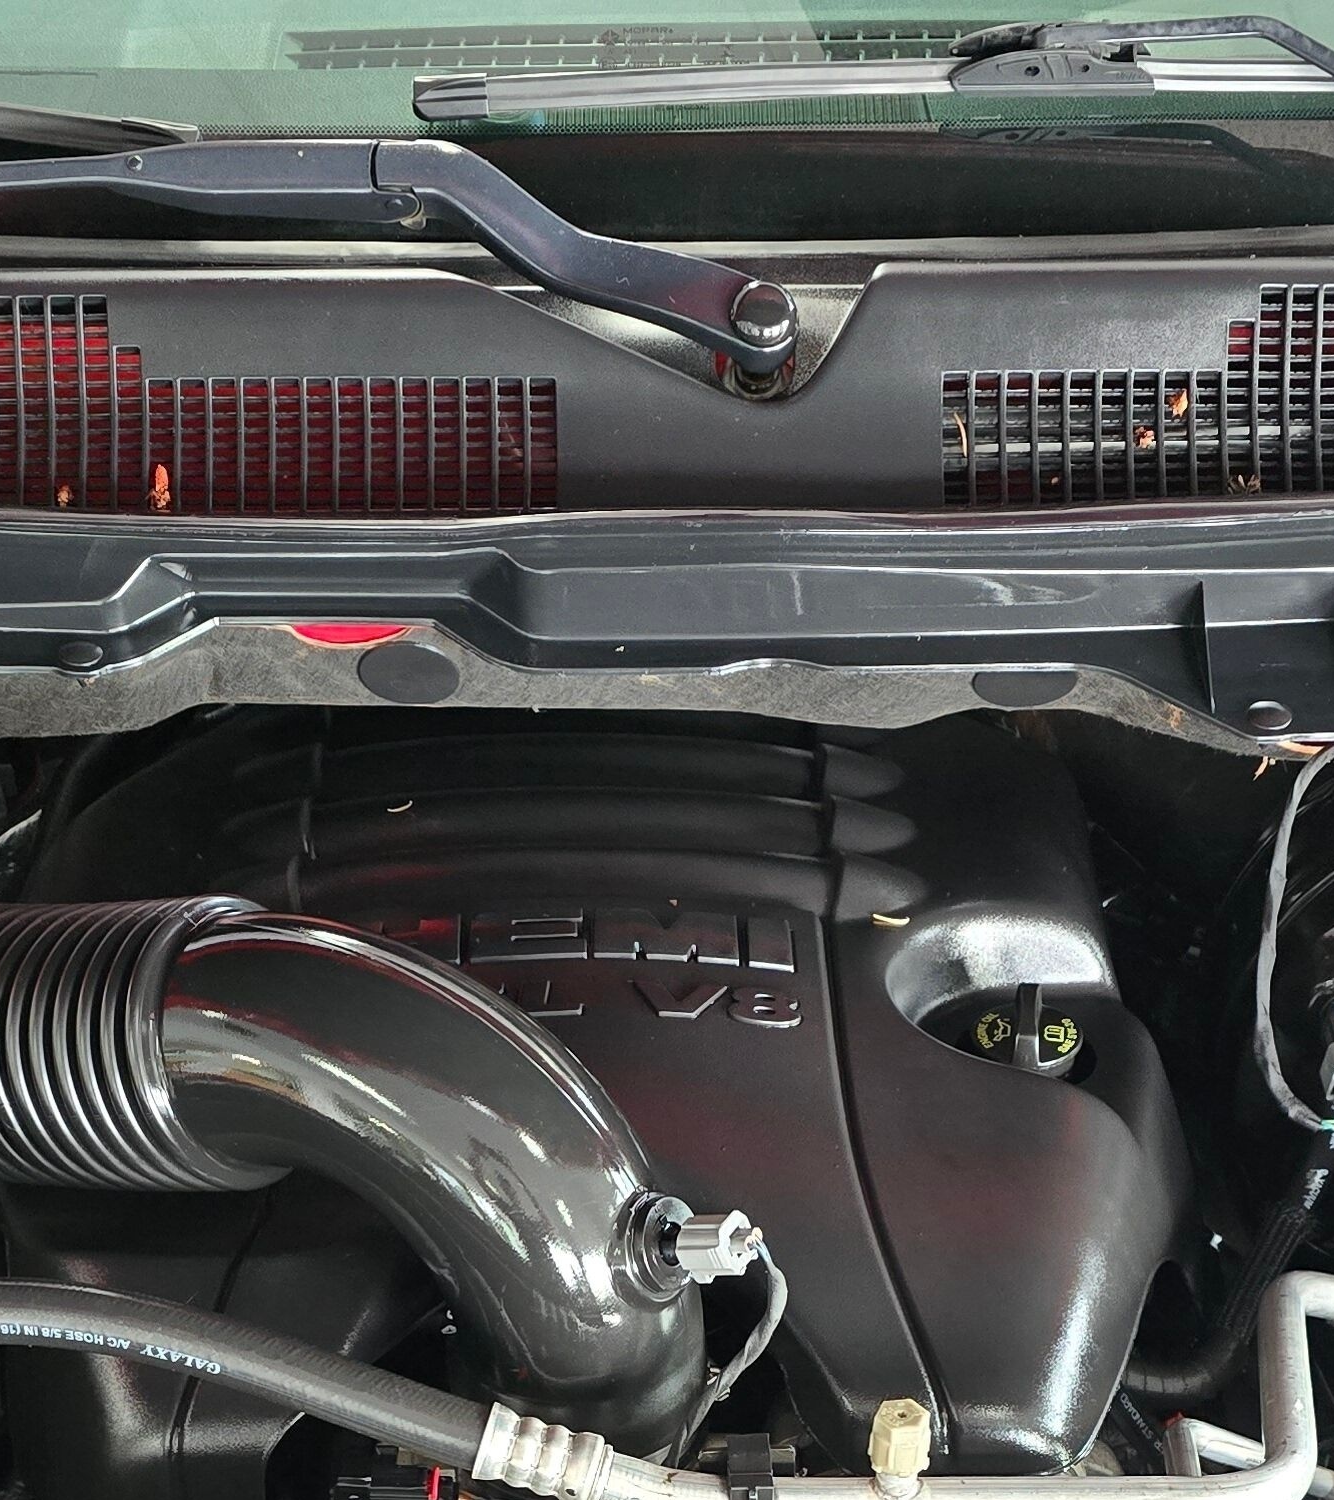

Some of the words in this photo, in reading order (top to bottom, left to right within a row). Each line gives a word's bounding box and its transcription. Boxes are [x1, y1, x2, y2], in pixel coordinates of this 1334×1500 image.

[629, 980, 803, 1028] V8
[977, 1023, 994, 1049] ENGINE
[0, 1323, 21, 1337] (16
[23, 1325, 39, 1337] IN
[40, 1325, 62, 1340] 5/8
[64, 1328, 105, 1346] HOSE
[106, 1335, 131, 1351] A/C
[140, 1343, 221, 1376] GALAXY
